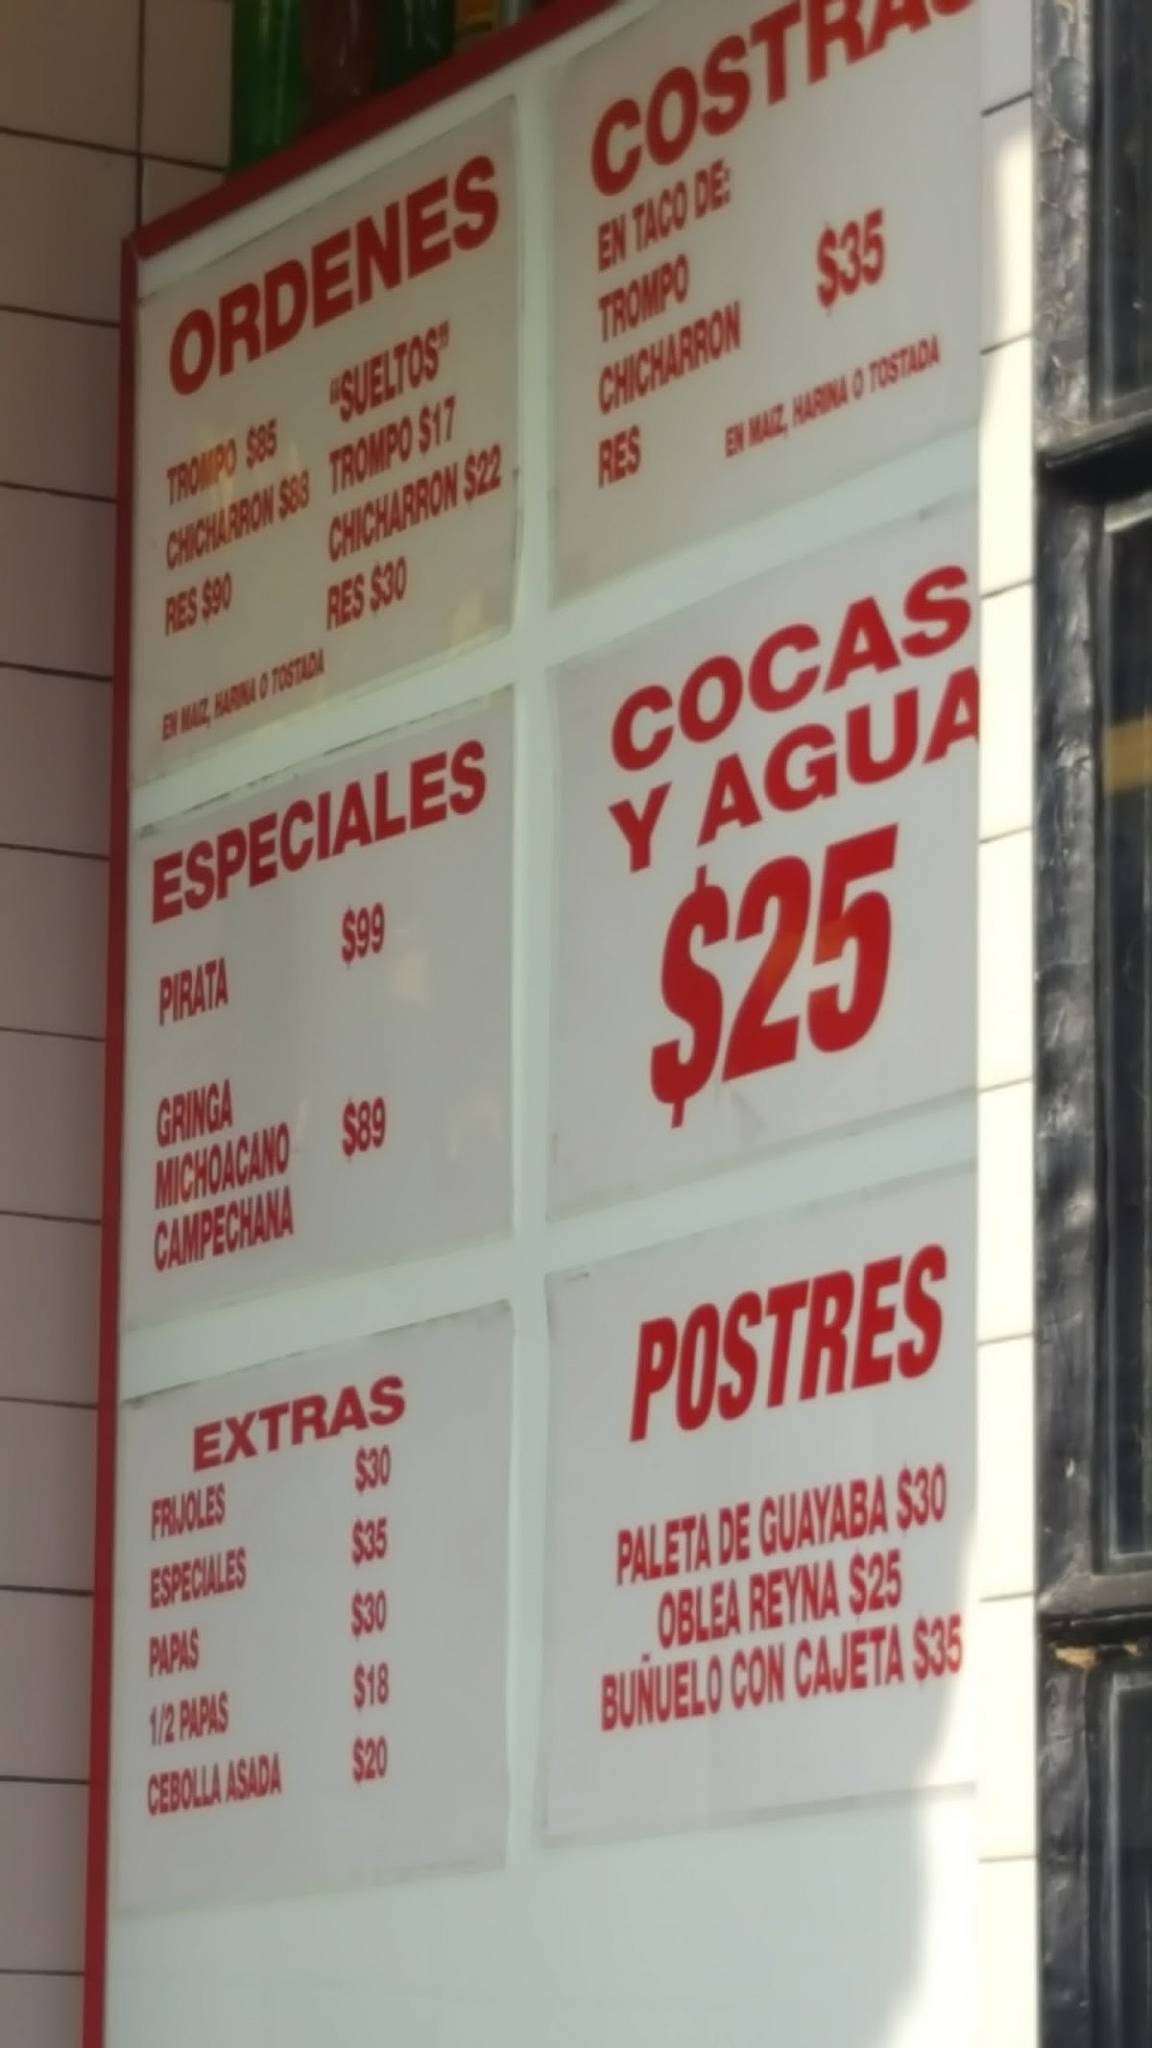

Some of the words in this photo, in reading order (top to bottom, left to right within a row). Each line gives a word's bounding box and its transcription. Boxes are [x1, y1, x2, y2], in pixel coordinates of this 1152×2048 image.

[591, 0, 978, 196] COSTRA
[598, 216, 626, 271] EN
[633, 180, 688, 252] TACO
[695, 158, 731, 220] DE:
[170, 155, 499, 395] ORDENES
[599, 254, 689, 342] TROMPO
[817, 208, 885, 316] $35
[599, 301, 741, 415] CHICHARRON
[725, 424, 744, 458] EN
[792, 374, 848, 428] HARINA
[853, 370, 864, 399] O
[868, 334, 940, 392] TOSTADA
[166, 438, 236, 505] TROMPO
[329, 416, 411, 494] TROMPO
[418, 395, 456, 454] $17
[598, 426, 641, 488] RES
[166, 485, 274, 570] CHICHARRON
[329, 462, 458, 562] CHICHARRON
[464, 444, 502, 502] $22
[165, 586, 198, 636] RES
[202, 571, 232, 624] $90
[327, 573, 365, 631] RES
[370, 555, 407, 617] $30
[162, 710, 177, 740] EN
[215, 673, 256, 720] HARINA
[260, 673, 269, 699] O
[272, 648, 324, 695] TOSTADA
[611, 565, 971, 771] COCAS
[608, 781, 672, 873] Y
[698, 666, 979, 846] AGUA
[152, 739, 487, 925] ESPECIALES
[341, 902, 385, 969] $99
[650, 822, 899, 1129] $25
[159, 958, 228, 1027] PIRATA
[157, 1079, 233, 1148] GRINGA
[342, 1096, 386, 1163] $89
[155, 1122, 290, 1211] MICHOACANO
[154, 1186, 294, 1272] CAMPECHANA
[629, 1244, 947, 1443] POSTRES
[193, 1375, 406, 1472] EXTRAS
[151, 1482, 226, 1541] FRIJOLES
[354, 1444, 391, 1494] $30
[352, 1517, 387, 1567] $35
[616, 1512, 710, 1586] PALETA
[718, 1502, 750, 1566] DE
[759, 1474, 887, 1555] GUAYABA
[896, 1460, 947, 1536] $30
[150, 1547, 246, 1609] ESPECIALES
[351, 1590, 387, 1640] $30
[658, 1578, 740, 1650] OBLEA
[749, 1559, 840, 1631] REYNA
[848, 1547, 901, 1619] $25
[149, 1628, 199, 1678] PAPAS
[353, 1661, 389, 1714] $18
[601, 1652, 721, 1731] BUÑUELO
[731, 1644, 785, 1709] CON
[795, 1622, 903, 1698] CAJETA
[913, 1609, 962, 1687] $35
[149, 1702, 174, 1746] 1/2
[180, 1691, 228, 1738] PAPAS
[353, 1735, 388, 1783] $20
[147, 1763, 221, 1816] CEBOLLA
[226, 1753, 281, 1800] ASADA
